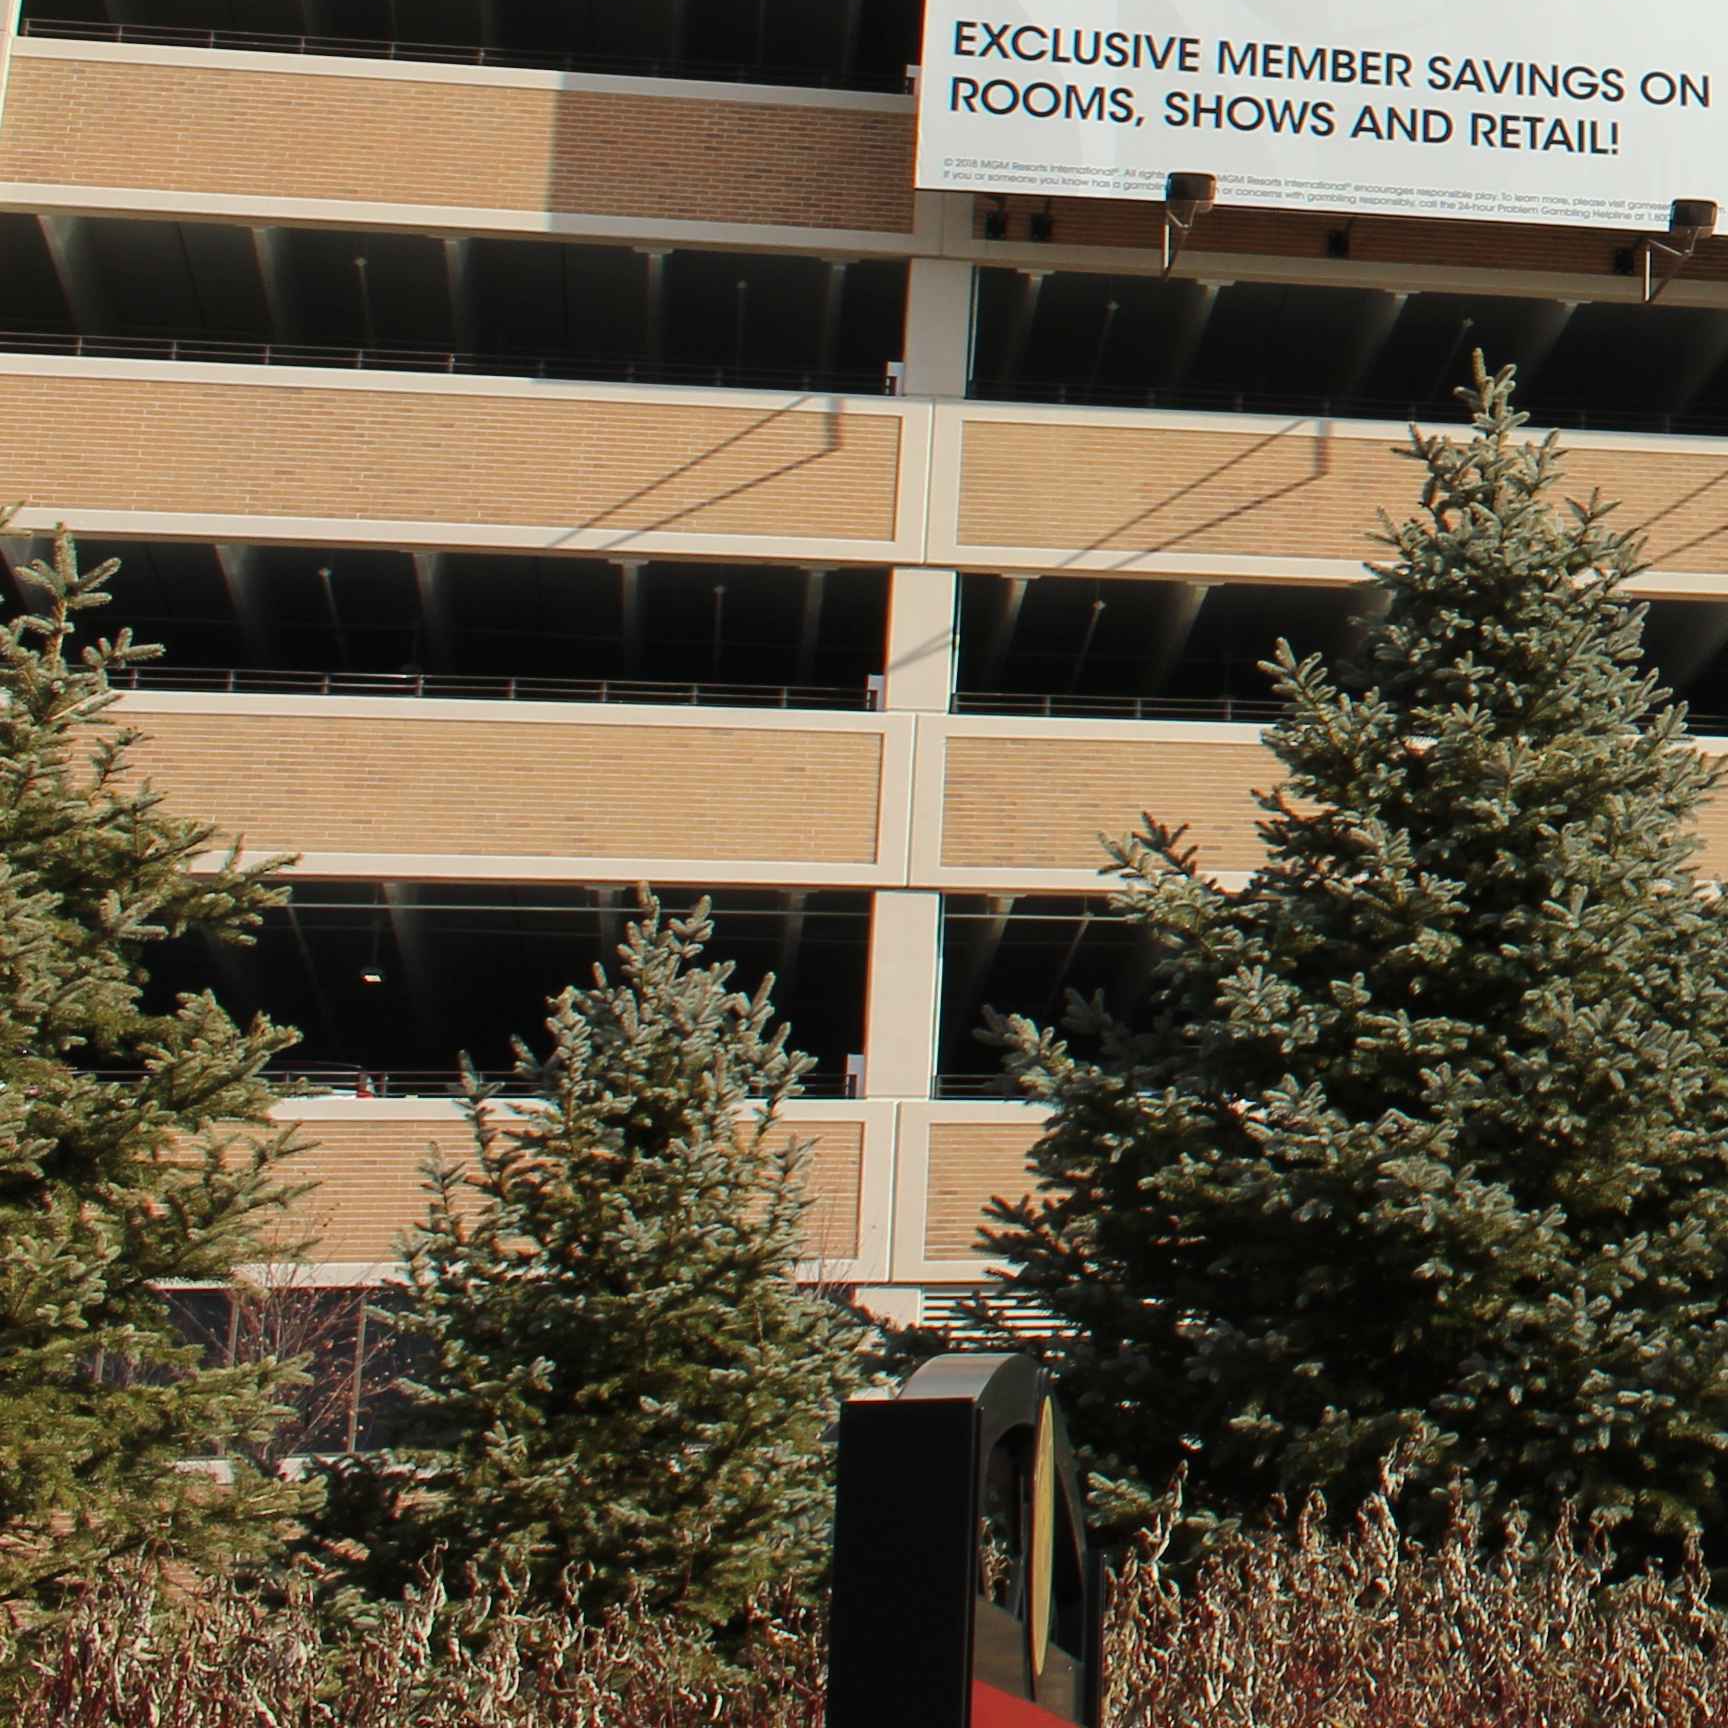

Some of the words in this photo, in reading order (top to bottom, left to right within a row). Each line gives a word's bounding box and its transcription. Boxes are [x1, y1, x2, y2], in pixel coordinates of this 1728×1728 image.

[954, 20, 1200, 73] EXCLUSIVE
[1217, 39, 1413, 88] MEMBER
[1427, 55, 1625, 102] SAVINGS
[1640, 70, 1711, 108] ON
[950, 76, 1145, 127] ROOMS,
[1164, 90, 1336, 139] SHOWS
[1350, 104, 1454, 144] AND
[1470, 112, 1620, 155] RETAIL!
